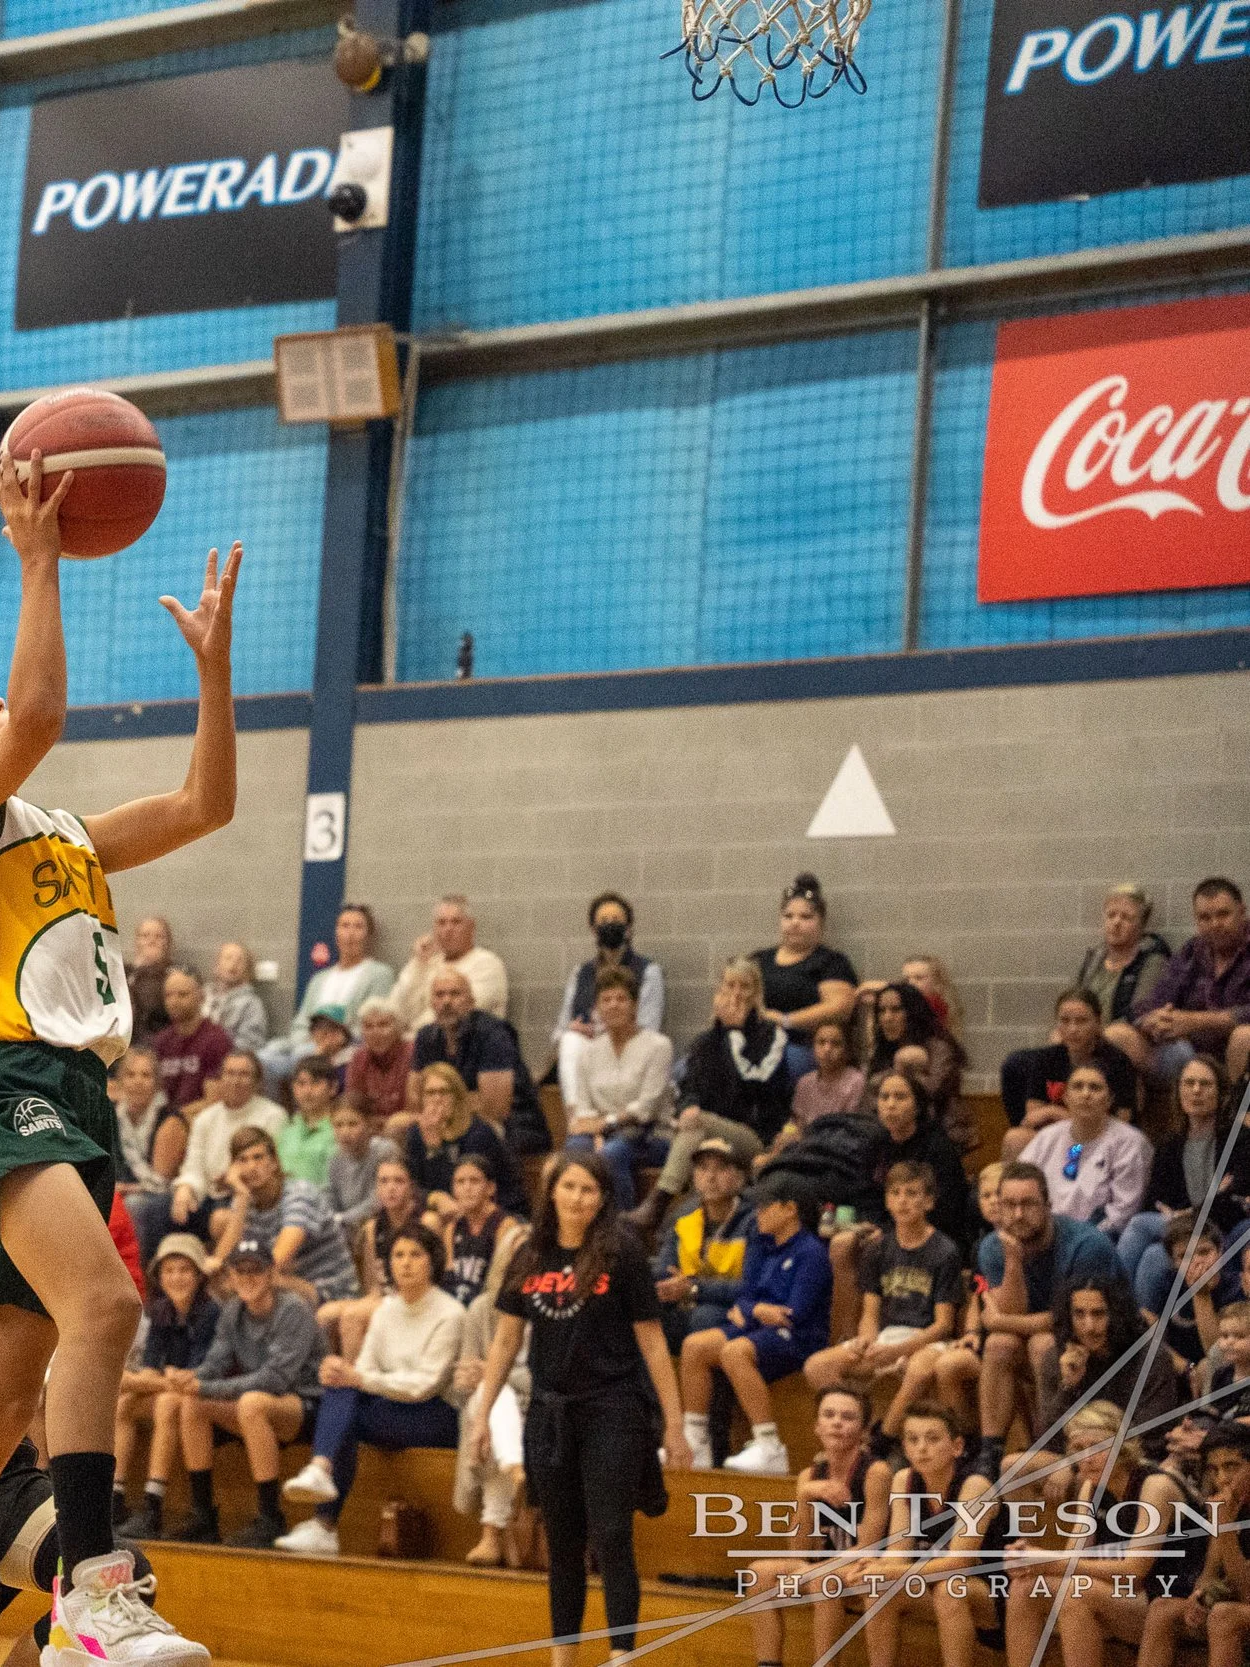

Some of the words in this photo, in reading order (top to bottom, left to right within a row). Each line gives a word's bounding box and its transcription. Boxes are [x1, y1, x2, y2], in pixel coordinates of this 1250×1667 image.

[31, 149, 340, 235] POWERAD
[313, 809, 336, 854] 3
[19, 1117, 63, 1137] SAINTS
[522, 1270, 611, 1295] DEVIS
